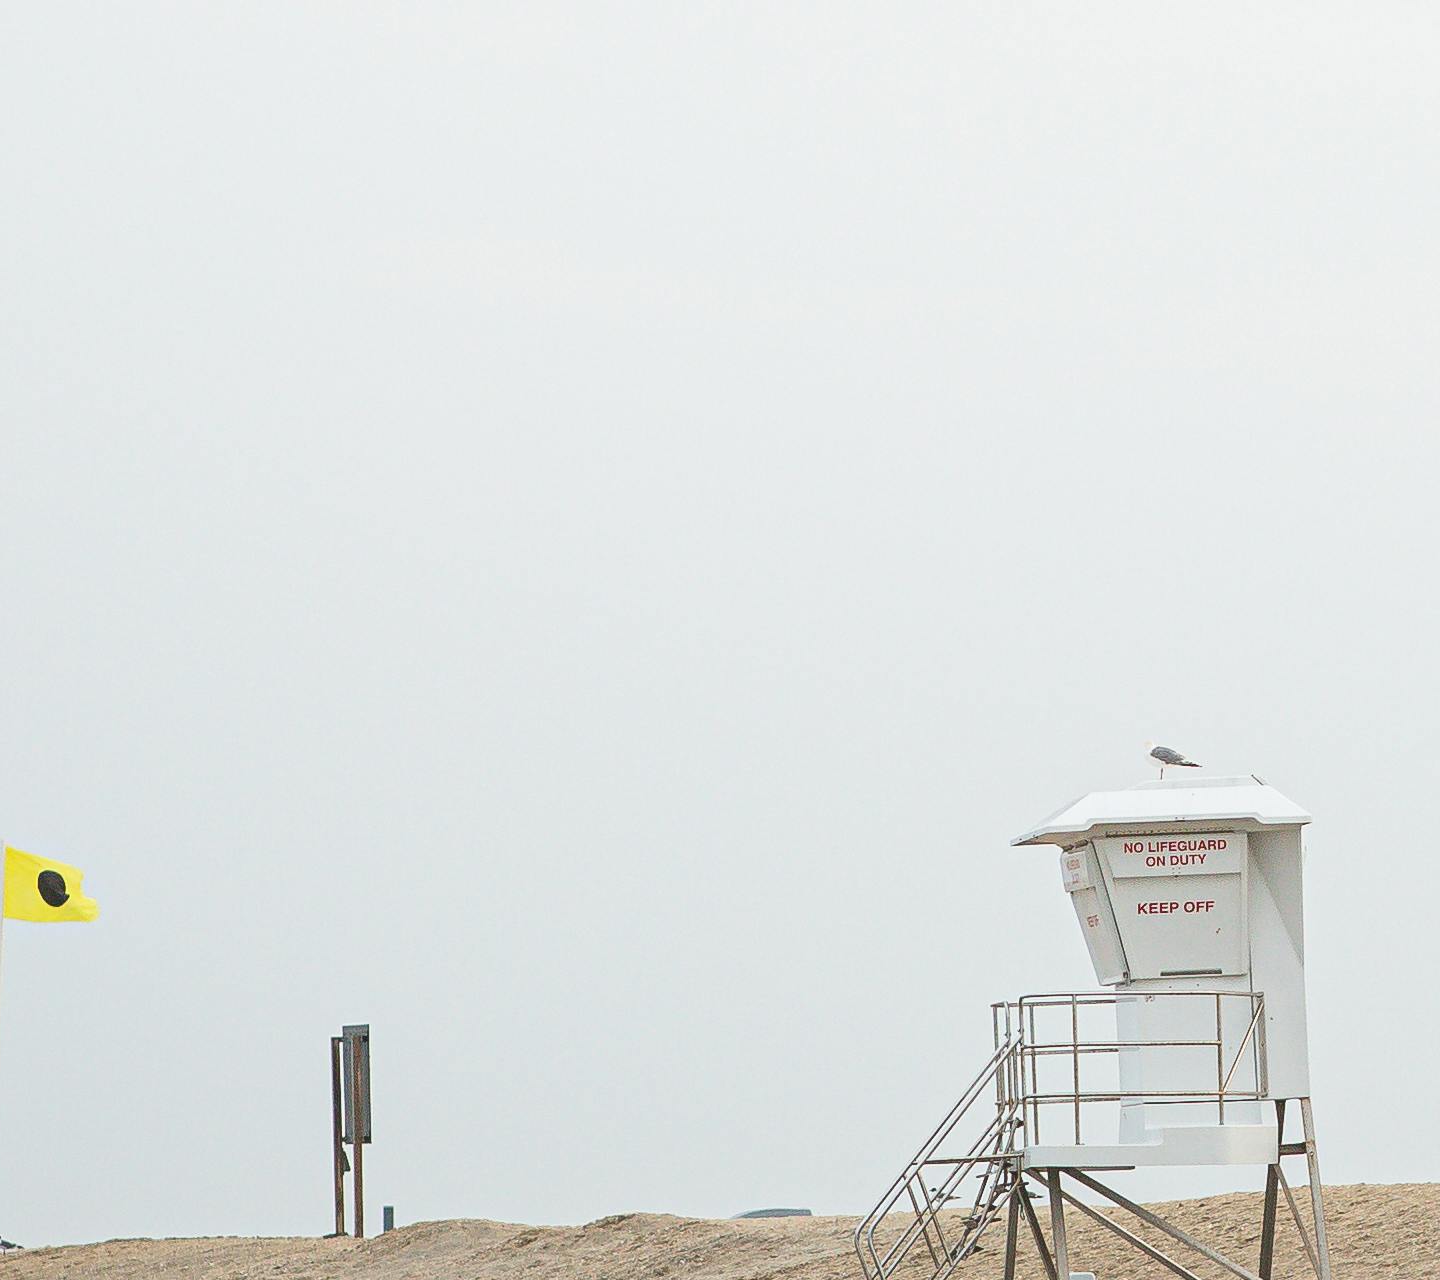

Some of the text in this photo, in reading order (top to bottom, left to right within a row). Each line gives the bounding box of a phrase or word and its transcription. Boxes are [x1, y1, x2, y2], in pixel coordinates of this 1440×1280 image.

[1123, 839, 1227, 854] NO LIFEGUARD
[1145, 853, 1207, 868] ON DUTY
[1137, 900, 1215, 915] KEEP OFF
